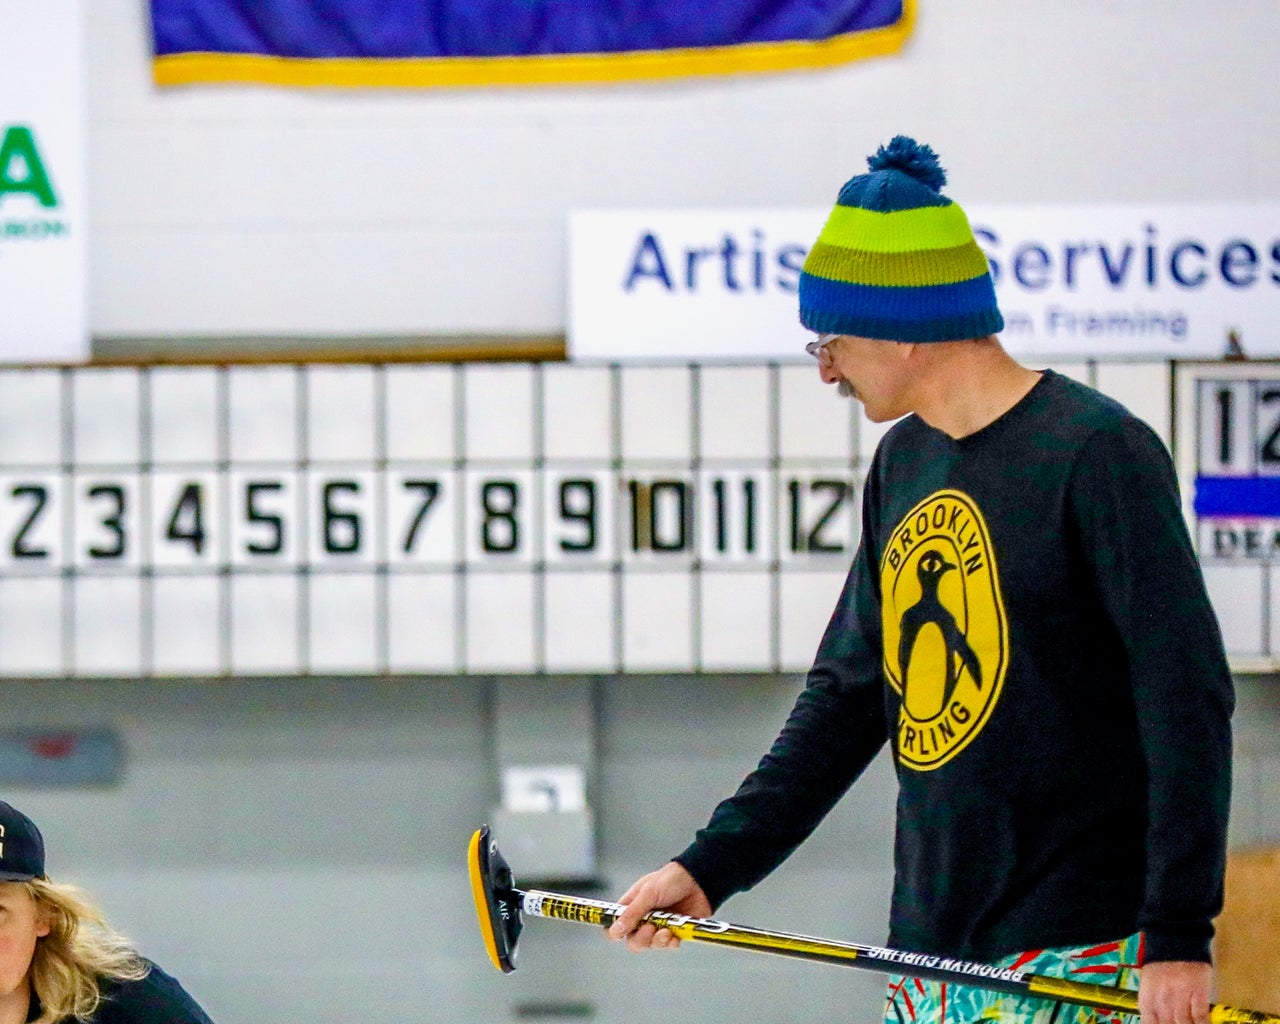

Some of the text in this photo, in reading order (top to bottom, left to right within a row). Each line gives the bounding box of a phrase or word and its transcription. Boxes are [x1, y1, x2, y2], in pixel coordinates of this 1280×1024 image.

[624, 230, 808, 293] Artis
[11, 486, 48, 559] 2
[87, 485, 126, 559] 3
[165, 483, 206, 556] 4
[246, 482, 284, 556] 5
[322, 481, 362, 555] 6
[403, 480, 440, 553] 7
[480, 480, 519, 554] 8
[558, 479, 597, 552] 9
[628, 480, 688, 553] 10
[712, 478, 756, 553] 11
[787, 479, 854, 554] 12
[888, 504, 983, 576] BROOKLYN
[900, 701, 971, 755] RLING
[498, 900, 509, 920] AIR
